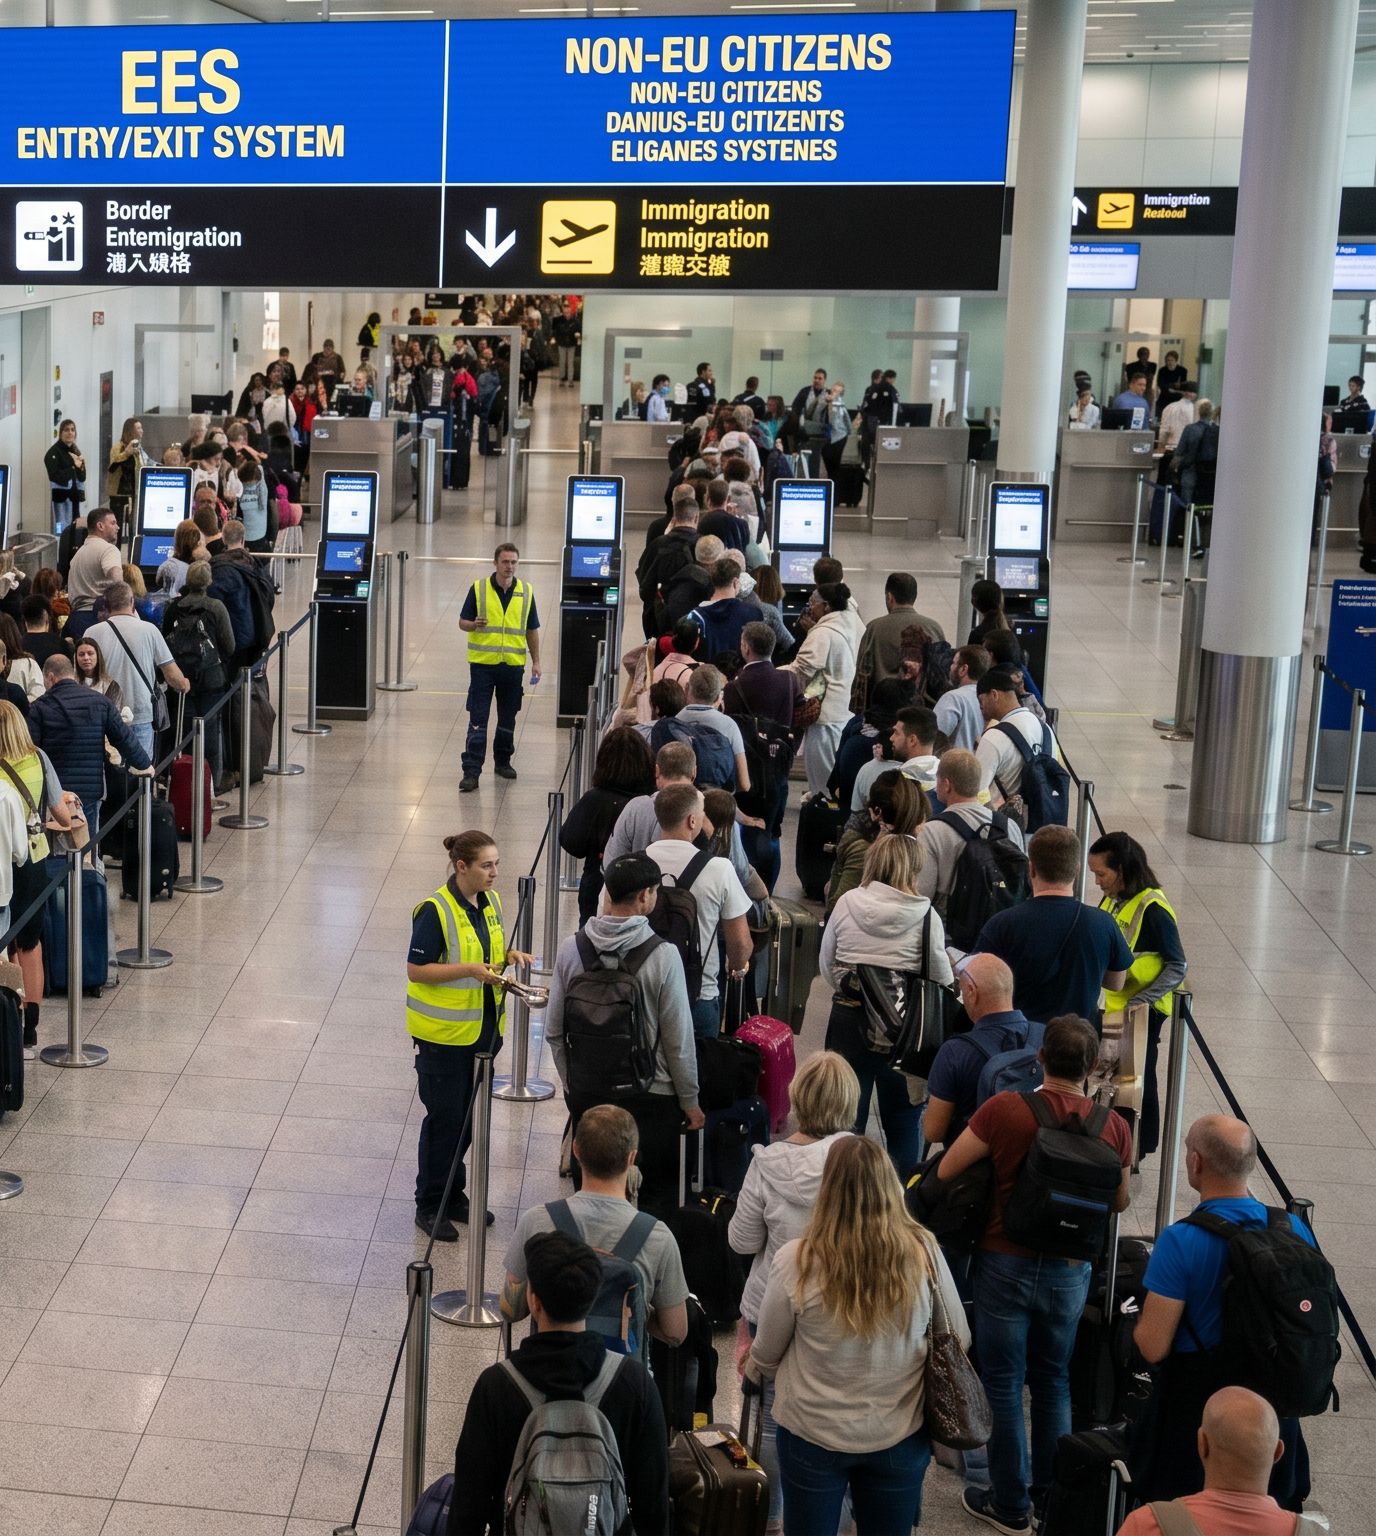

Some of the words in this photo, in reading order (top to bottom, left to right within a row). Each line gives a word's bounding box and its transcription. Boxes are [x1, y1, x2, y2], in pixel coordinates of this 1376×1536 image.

[565, 36, 709, 74] NON-EU
[720, 33, 892, 73] CITIZENS
[121, 48, 241, 115] EES
[630, 81, 716, 104] NON-EU
[721, 80, 822, 104] CITIZENS
[606, 110, 725, 133] DANIUS-EU
[731, 109, 845, 133] CITIZENTS
[17, 126, 205, 159] ENTRY/EXIT
[213, 125, 345, 158] SYSTEM
[611, 140, 718, 162] ELIGANES
[723, 139, 838, 162] SYSTENES
[106, 200, 172, 221] Border
[641, 198, 770, 225] Immigration
[106, 226, 242, 251] Entemigration
[640, 226, 769, 253] Immigration
